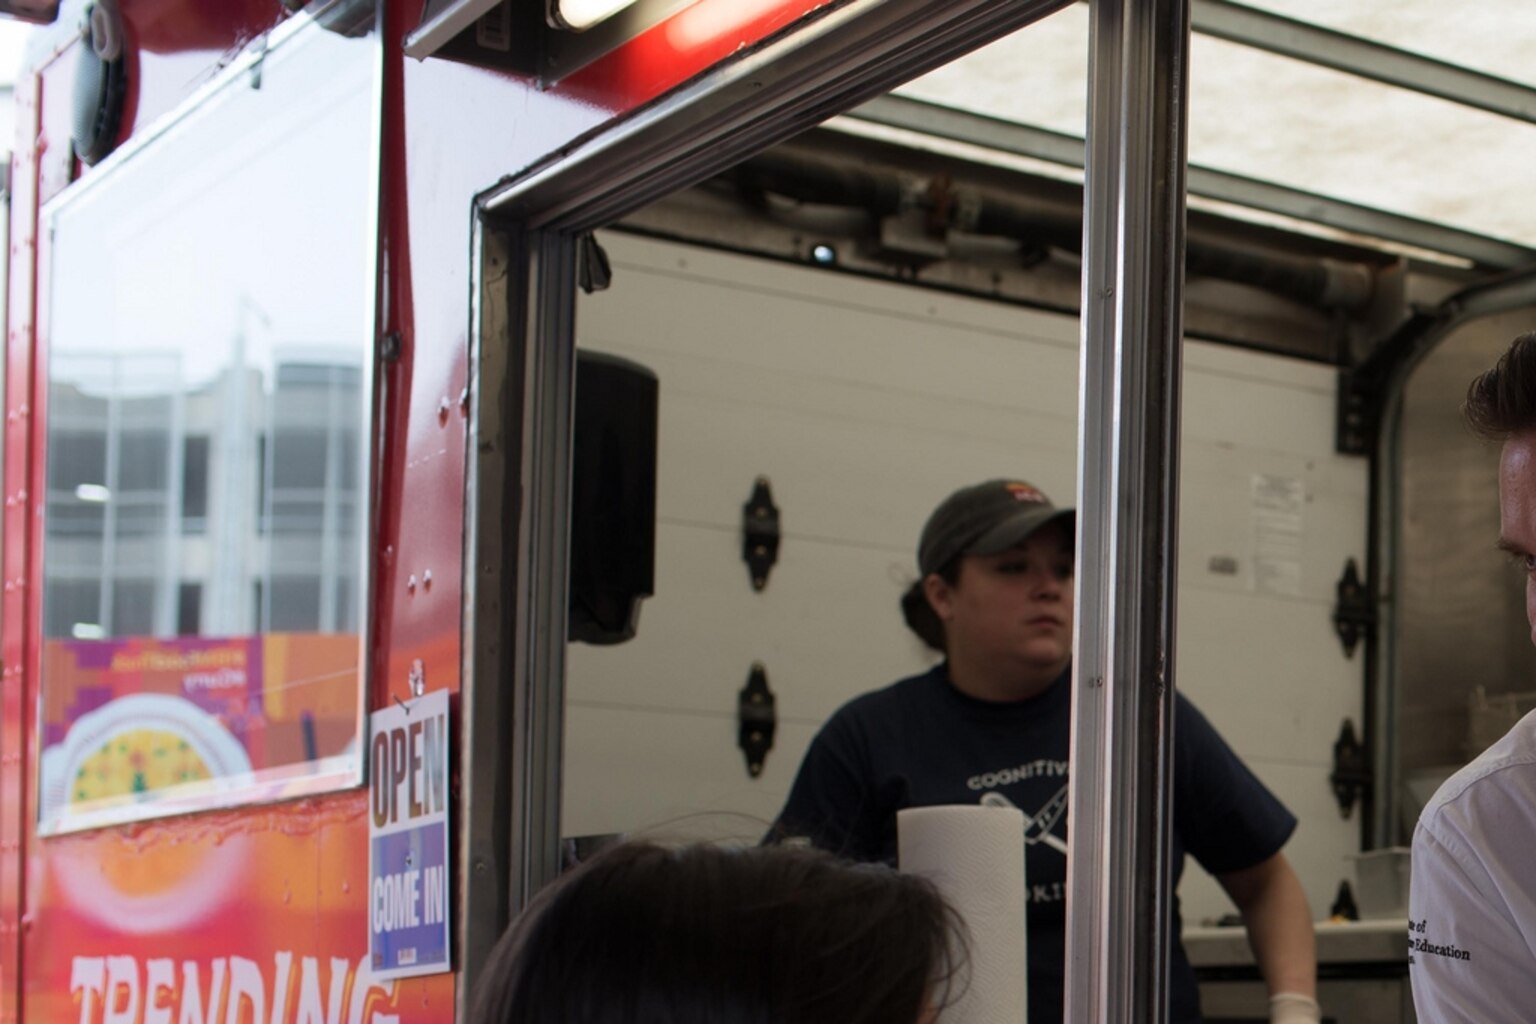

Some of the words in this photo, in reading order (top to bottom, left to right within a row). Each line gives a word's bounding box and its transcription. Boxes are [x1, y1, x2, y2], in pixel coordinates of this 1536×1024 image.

[372, 713, 445, 829] OPEN
[966, 758, 1069, 791] COGNITIV
[373, 868, 420, 935] COME
[424, 864, 444, 926] IN
[1416, 919, 1427, 933] of
[1415, 938, 1471, 961] Education
